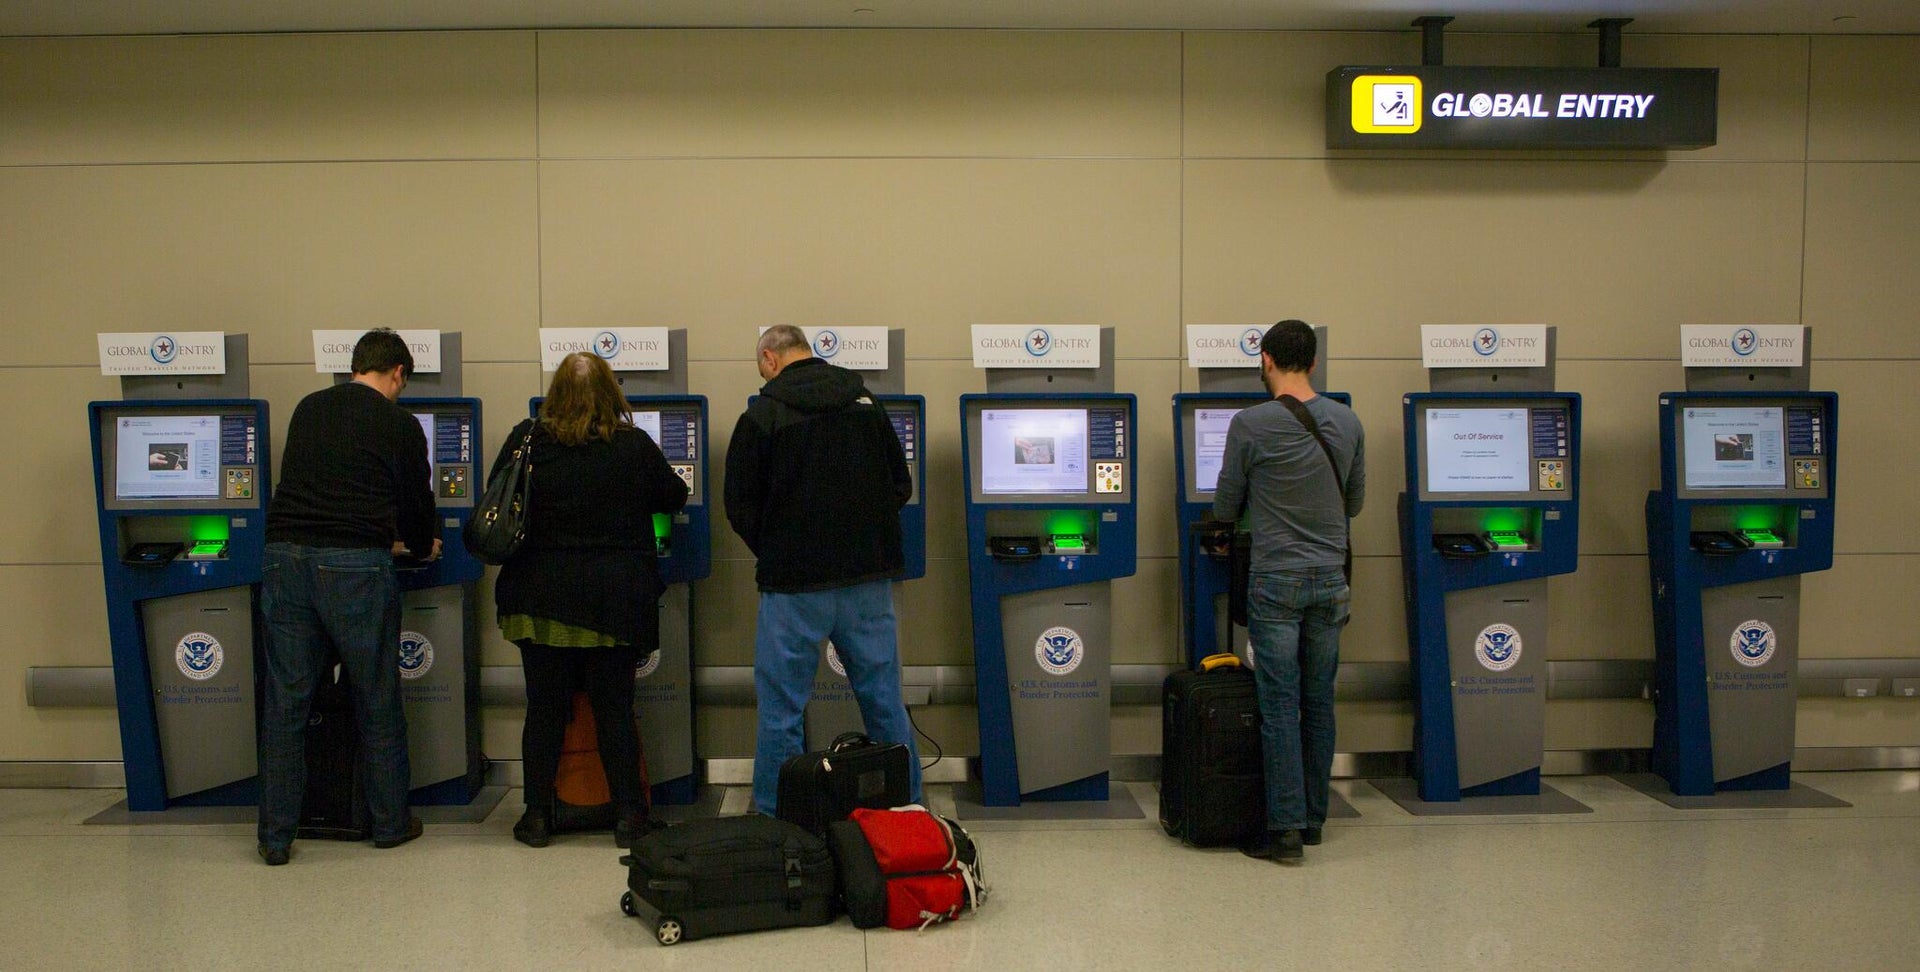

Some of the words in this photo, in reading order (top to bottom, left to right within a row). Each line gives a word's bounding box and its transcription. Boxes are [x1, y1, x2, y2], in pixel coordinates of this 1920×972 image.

[1432, 93, 1549, 117] GLOBAL
[1556, 94, 1655, 118] ENTRY
[406, 343, 431, 353] TRY
[549, 342, 591, 352] GLOBAL
[622, 341, 659, 351] ENTRY
[841, 340, 880, 350] ENTRY
[980, 338, 1022, 349] GLOBAL
[1054, 338, 1091, 349] ENTRY
[1195, 338, 1237, 349] GLOBAL
[1430, 338, 1472, 348] GLOBAL
[1501, 338, 1538, 348] ENTRY
[1688, 338, 1730, 348] GLOBAL
[1759, 338, 1796, 348] ENTRY
[107, 346, 149, 356] GLOBAL
[179, 345, 216, 355] ENTRY
[1479, 676, 1517, 684] Customs
[1519, 675, 1534, 683] and
[1733, 672, 1770, 680] Customs
[1772, 671, 1788, 679] and
[181, 685, 220, 693] Customs
[222, 683, 239, 692] and
[1040, 680, 1078, 688] Customs
[1081, 679, 1097, 687] and
[1747, 682, 1789, 690] Protection
[1020, 691, 1049, 699] Border
[1458, 687, 1489, 695] Border
[163, 695, 191, 704] Border
[195, 695, 242, 703] Protection
